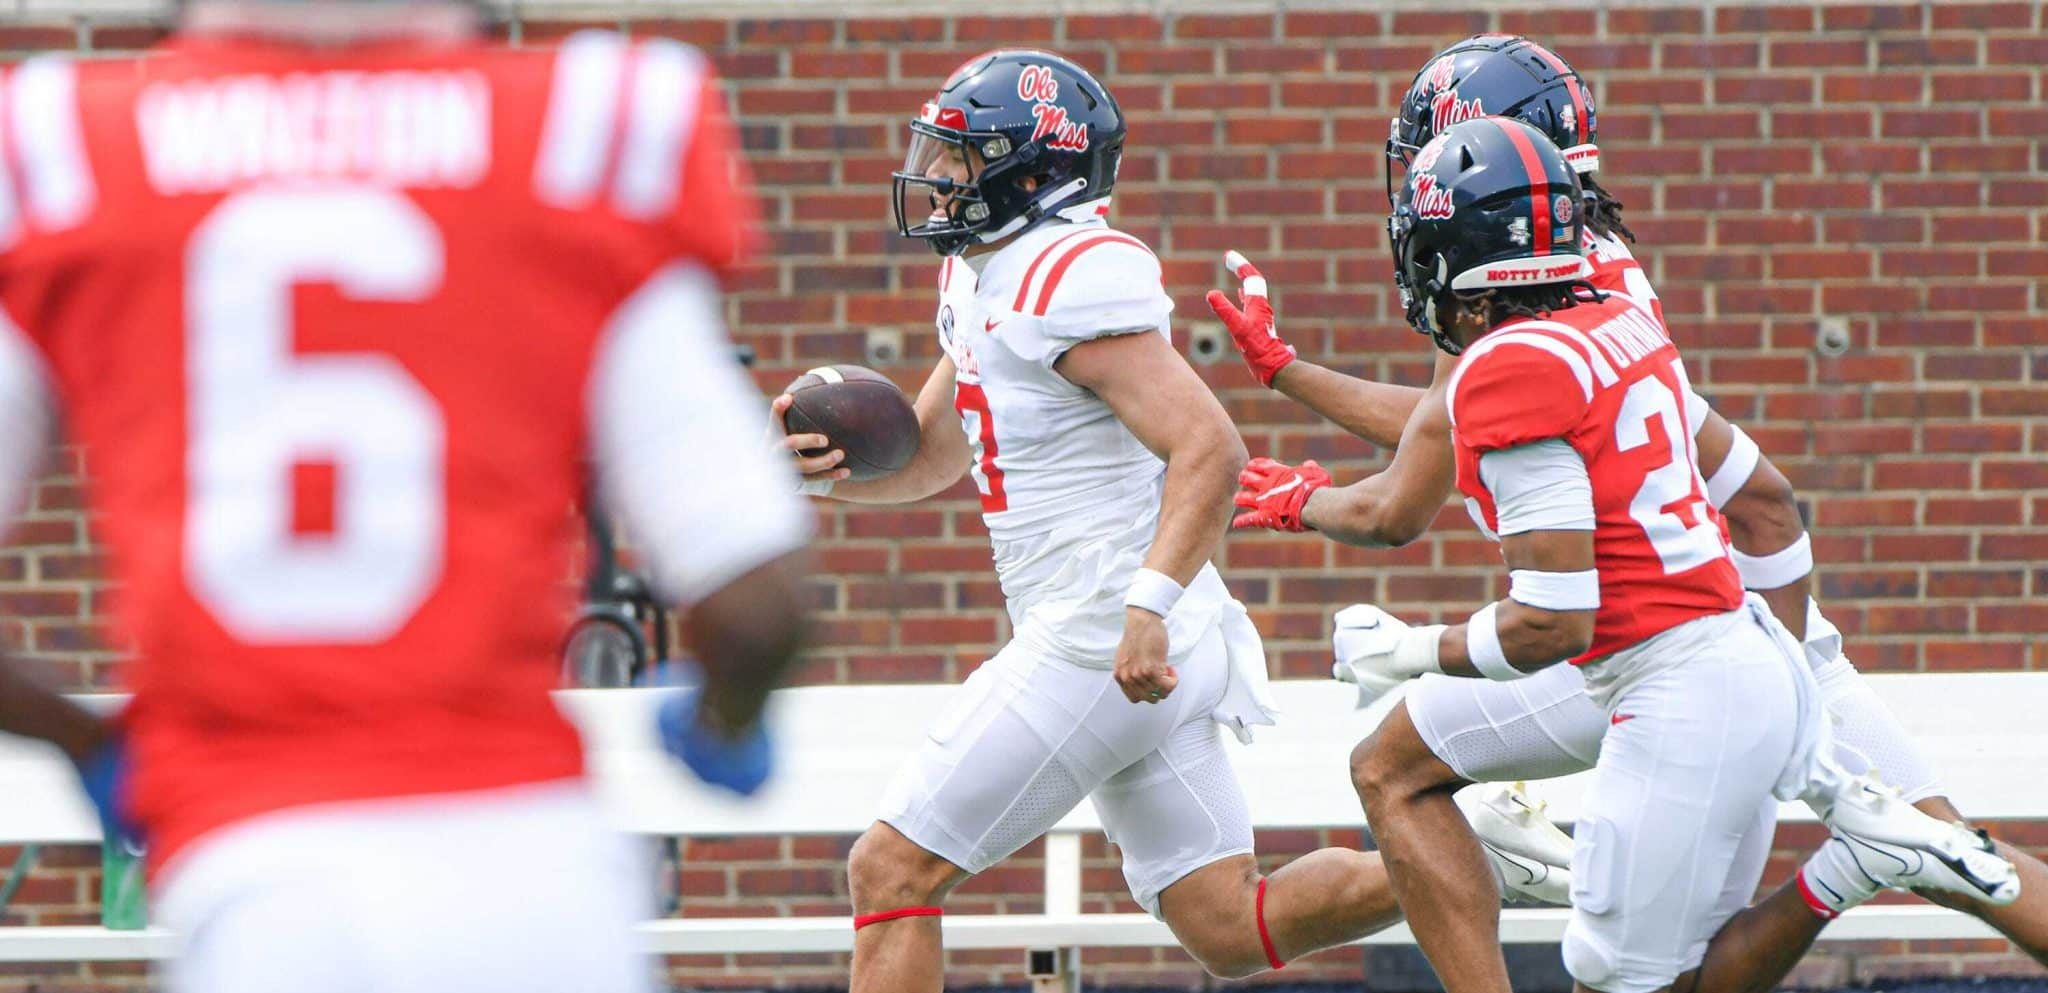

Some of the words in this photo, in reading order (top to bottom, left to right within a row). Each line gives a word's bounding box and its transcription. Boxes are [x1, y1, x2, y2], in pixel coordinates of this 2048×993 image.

[1018, 65, 1057, 103] Ole
[1031, 103, 1089, 152] Miss
[1410, 173, 1455, 220] Miss
[1487, 269, 1540, 281] HOTTY
[184, 182, 447, 646] 6
